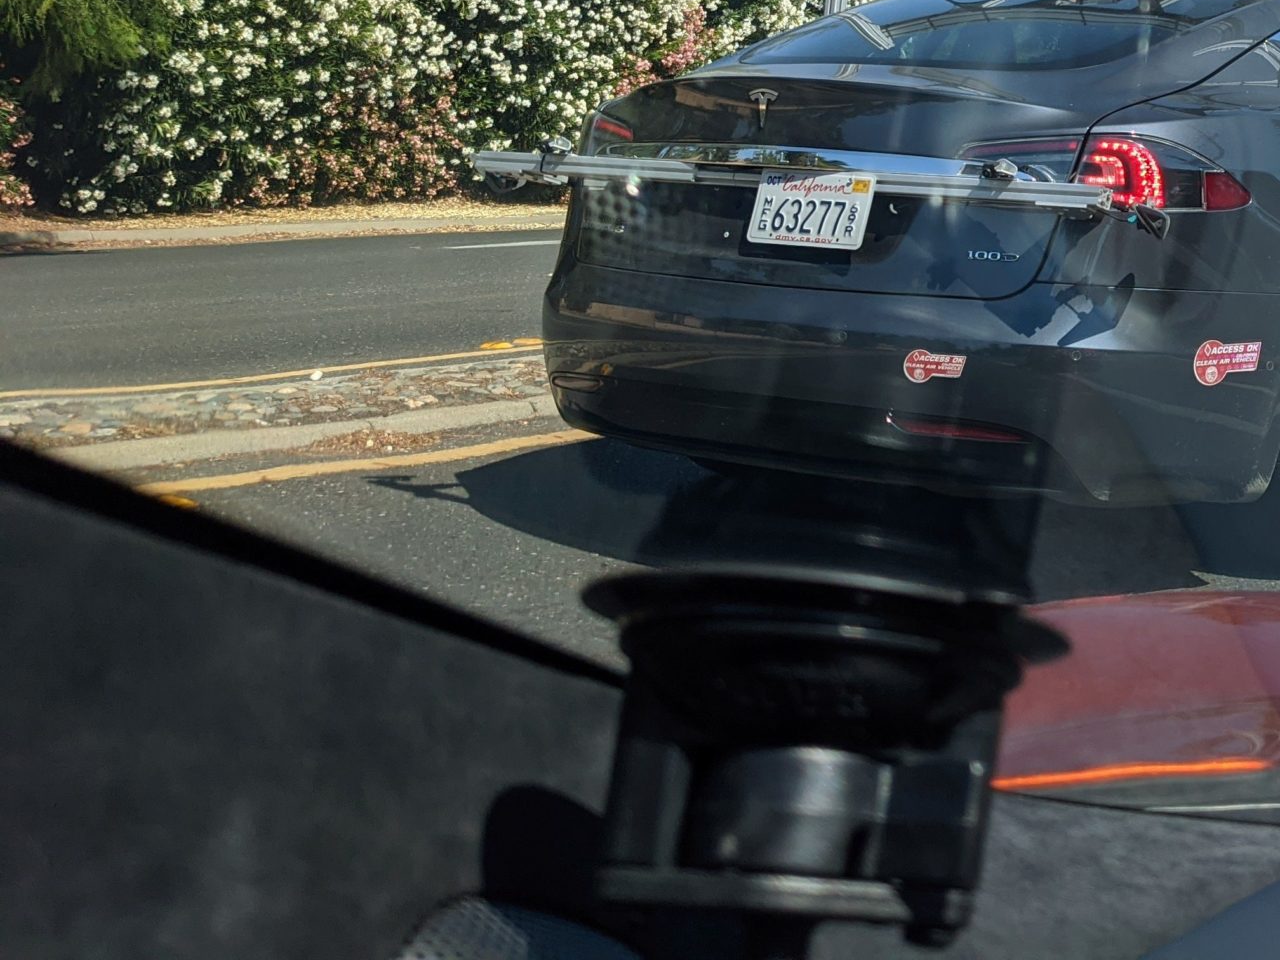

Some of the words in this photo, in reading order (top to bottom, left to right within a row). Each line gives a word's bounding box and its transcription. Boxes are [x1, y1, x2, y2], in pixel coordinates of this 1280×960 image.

[766, 175, 783, 186] OCT
[782, 174, 853, 198] California
[771, 198, 847, 237] 63277
[775, 234, 834, 244] dmv.ca.gov
[1210, 344, 1245, 355] ACCESS
[1246, 343, 1259, 352] OK
[918, 354, 951, 363] ACCESS
[952, 356, 965, 364] OK
[1196, 359, 1218, 367] CLEAN
